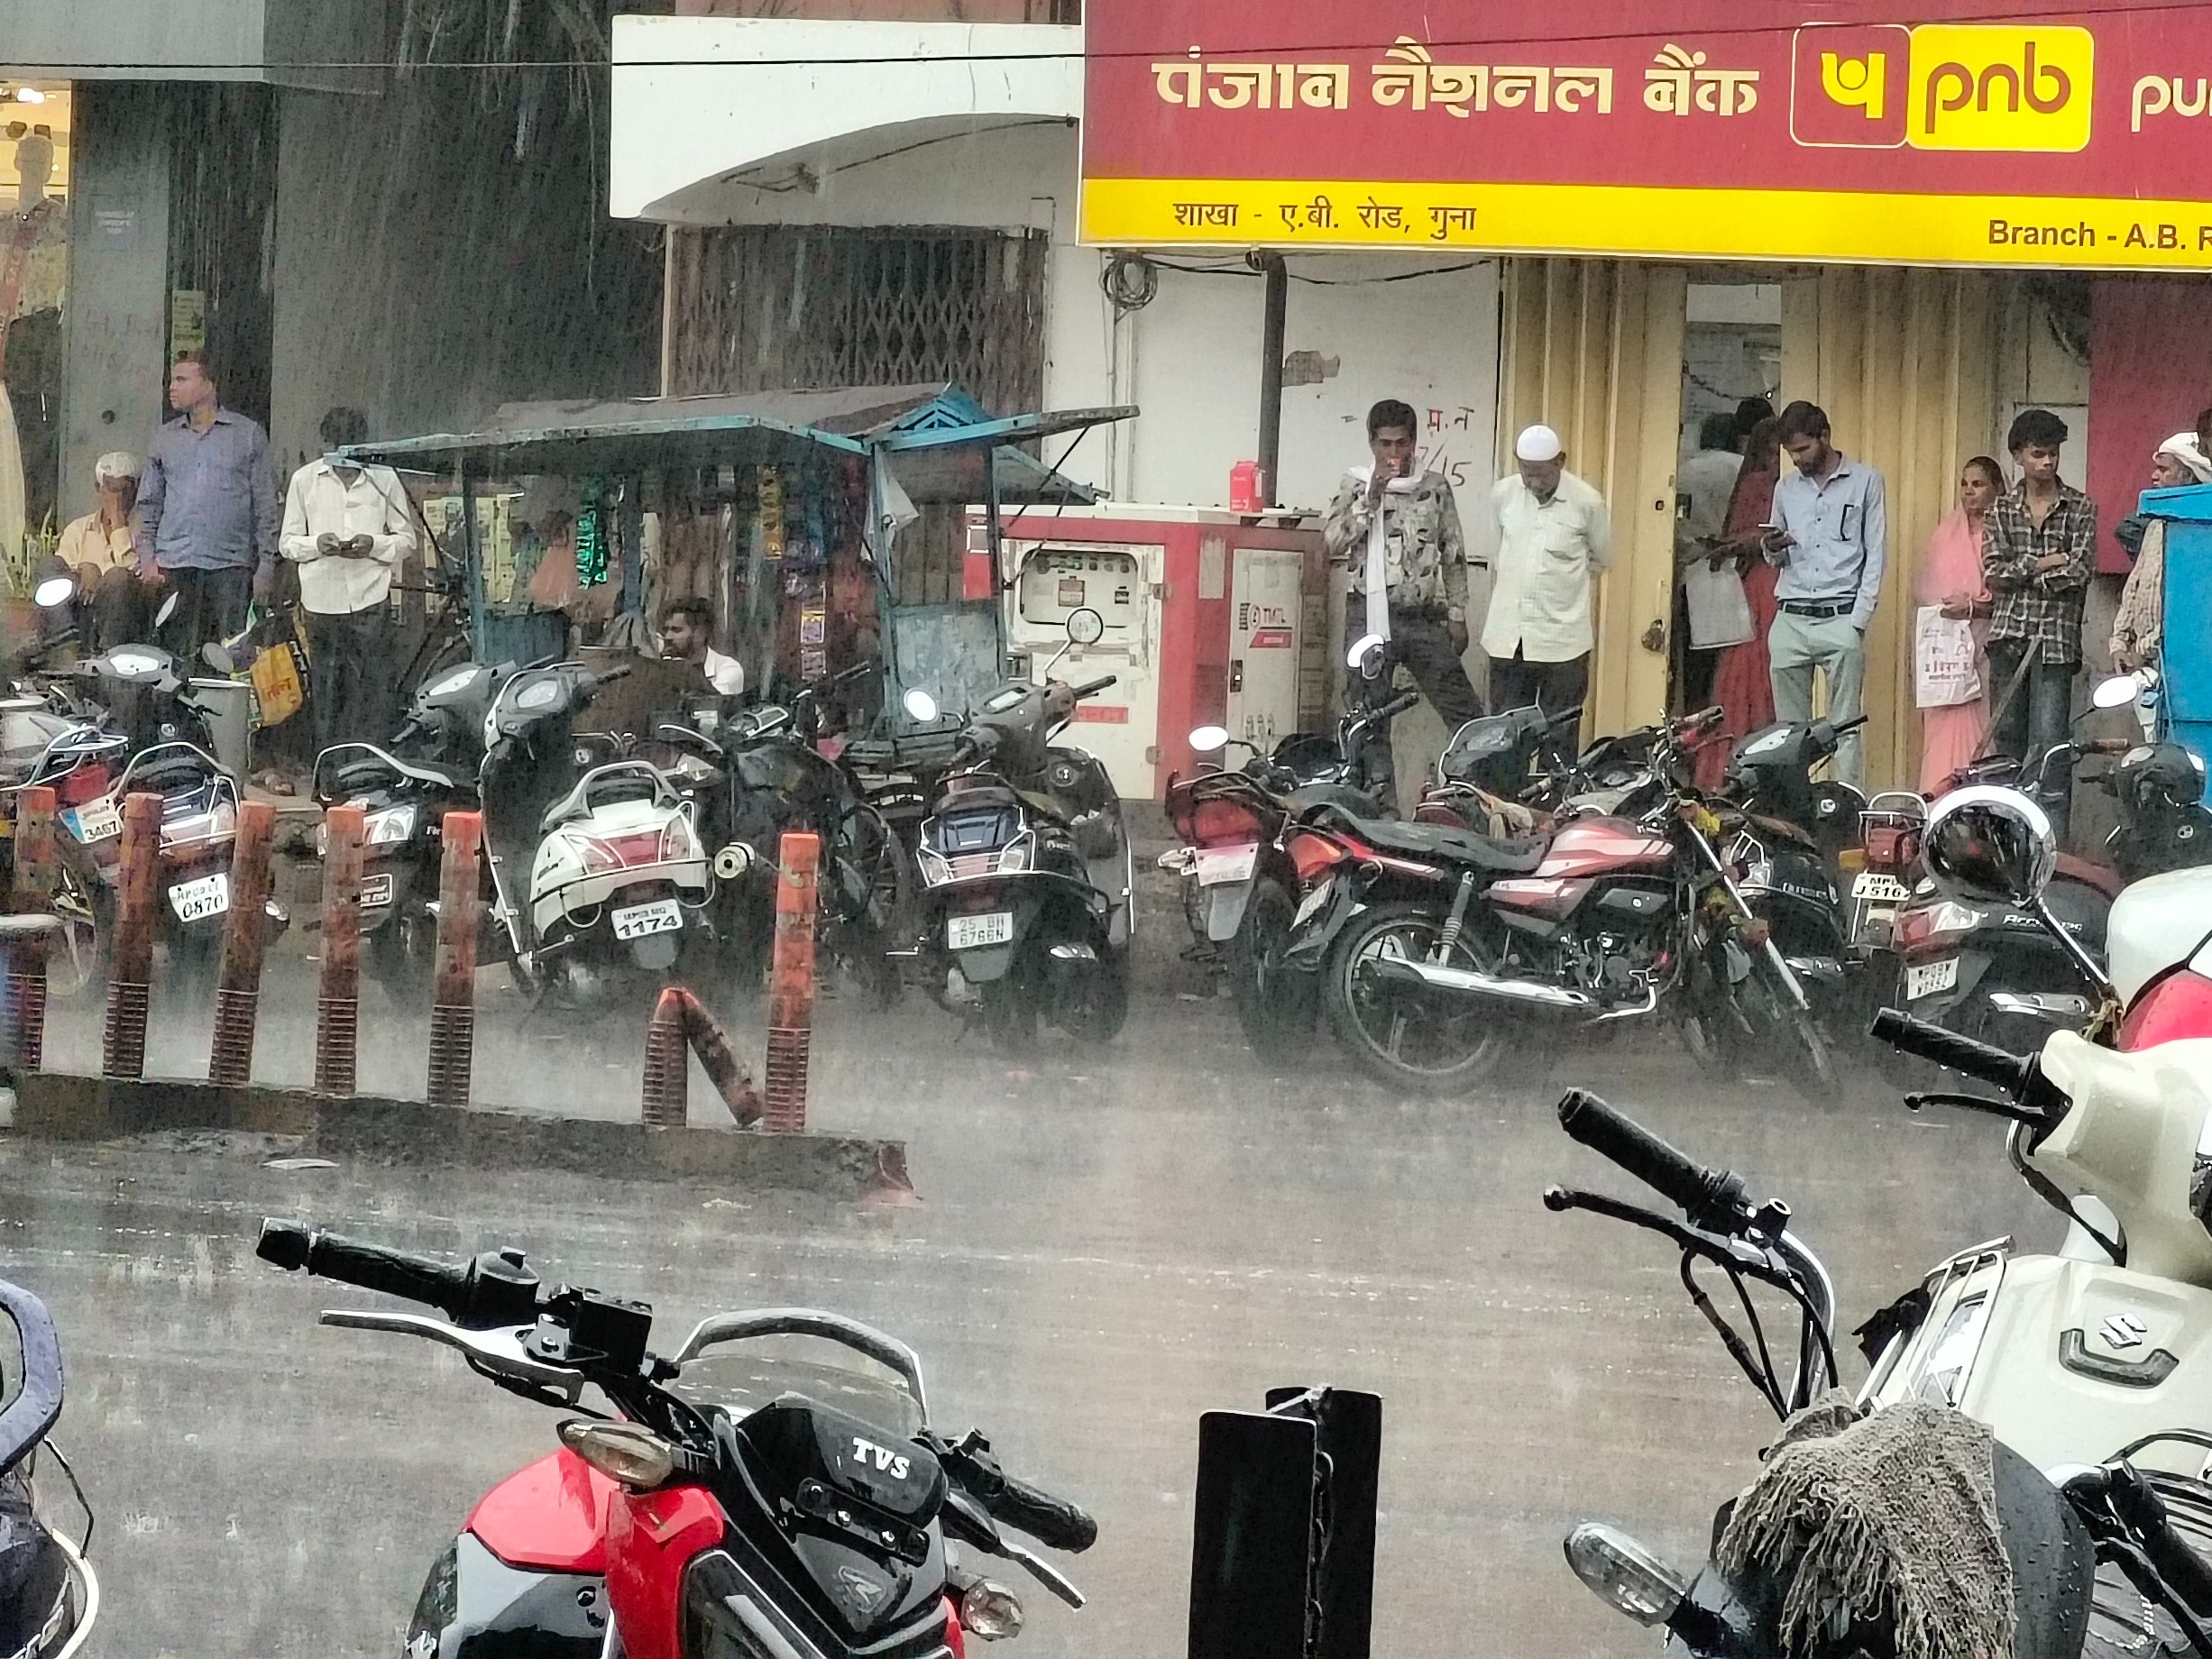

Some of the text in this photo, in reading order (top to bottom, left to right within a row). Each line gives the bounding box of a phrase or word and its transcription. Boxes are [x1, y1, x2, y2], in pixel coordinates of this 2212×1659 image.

[1152, 35, 1759, 118] पंजाब नैशनल बैंक
[1924, 41, 2071, 133] pnb
[2131, 75, 2212, 133] pu
[1172, 203, 1239, 227] शाखा
[1279, 195, 1339, 233] ए.बी.
[1356, 196, 1410, 234] रोड,
[1427, 206, 1477, 240] गुना
[1988, 219, 2096, 247] Branch
[2124, 223, 2187, 249] A.B.
[182, 894, 223, 919] 0870
[618, 915, 678, 937] 1174
[852, 1436, 911, 1480] TVS
